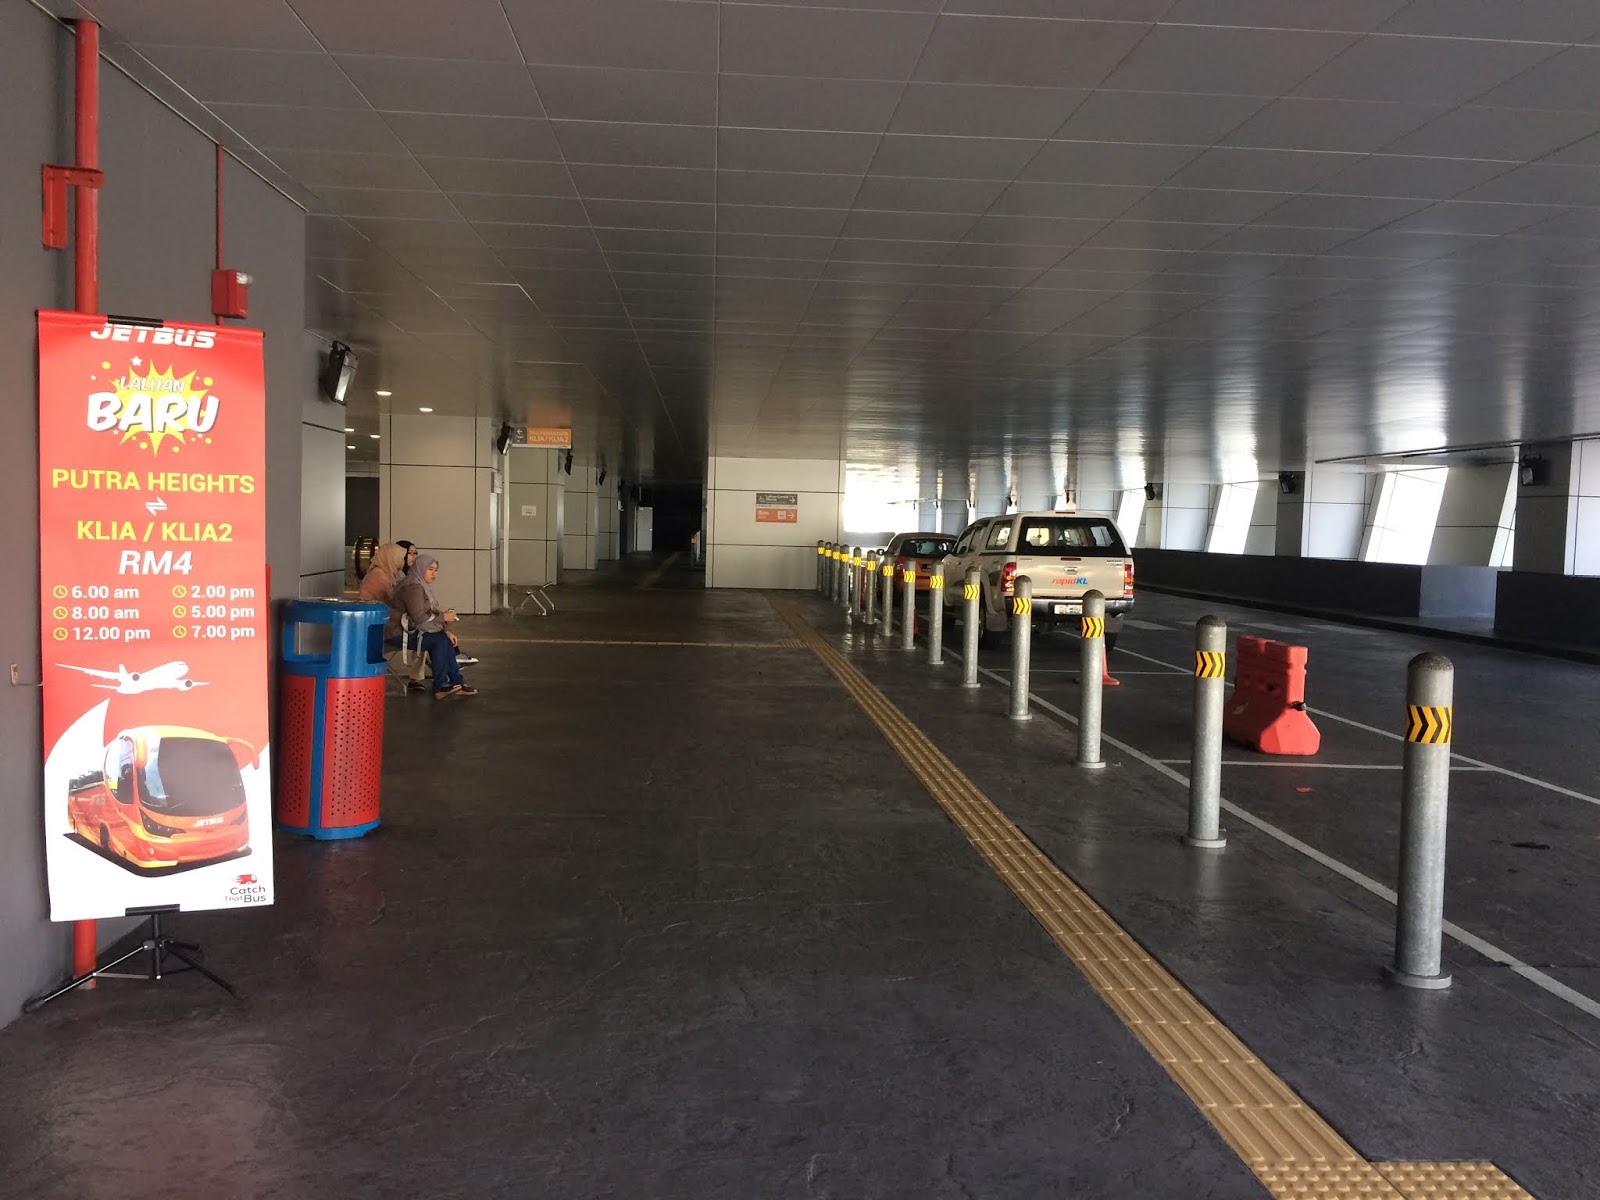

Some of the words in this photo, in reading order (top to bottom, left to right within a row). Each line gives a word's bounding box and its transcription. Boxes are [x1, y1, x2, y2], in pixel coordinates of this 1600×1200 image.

[90, 322, 216, 348] JETBUS
[119, 376, 185, 393] LALUAN
[87, 392, 220, 433] BARU
[52, 469, 141, 491] PUTRA
[147, 472, 255, 494] HEIGHTS
[77, 520, 137, 541] KLIA
[142, 522, 154, 542] /
[161, 523, 233, 542] KLIA2
[118, 550, 193, 575] RM4
[71, 585, 109, 599] 6.00
[113, 588, 140, 599] am
[191, 585, 226, 599] 2.00
[230, 587, 255, 600] pm
[71, 606, 109, 620] 8.00
[113, 609, 140, 620] am
[191, 605, 226, 618] 5.00
[230, 607, 255, 621] pm
[73, 627, 120, 640] 12.00
[125, 629, 151, 642] pm
[192, 625, 226, 638] 7.00
[230, 627, 255, 641] pm
[229, 885, 265, 895] Catch
[243, 894, 267, 903] Bus
